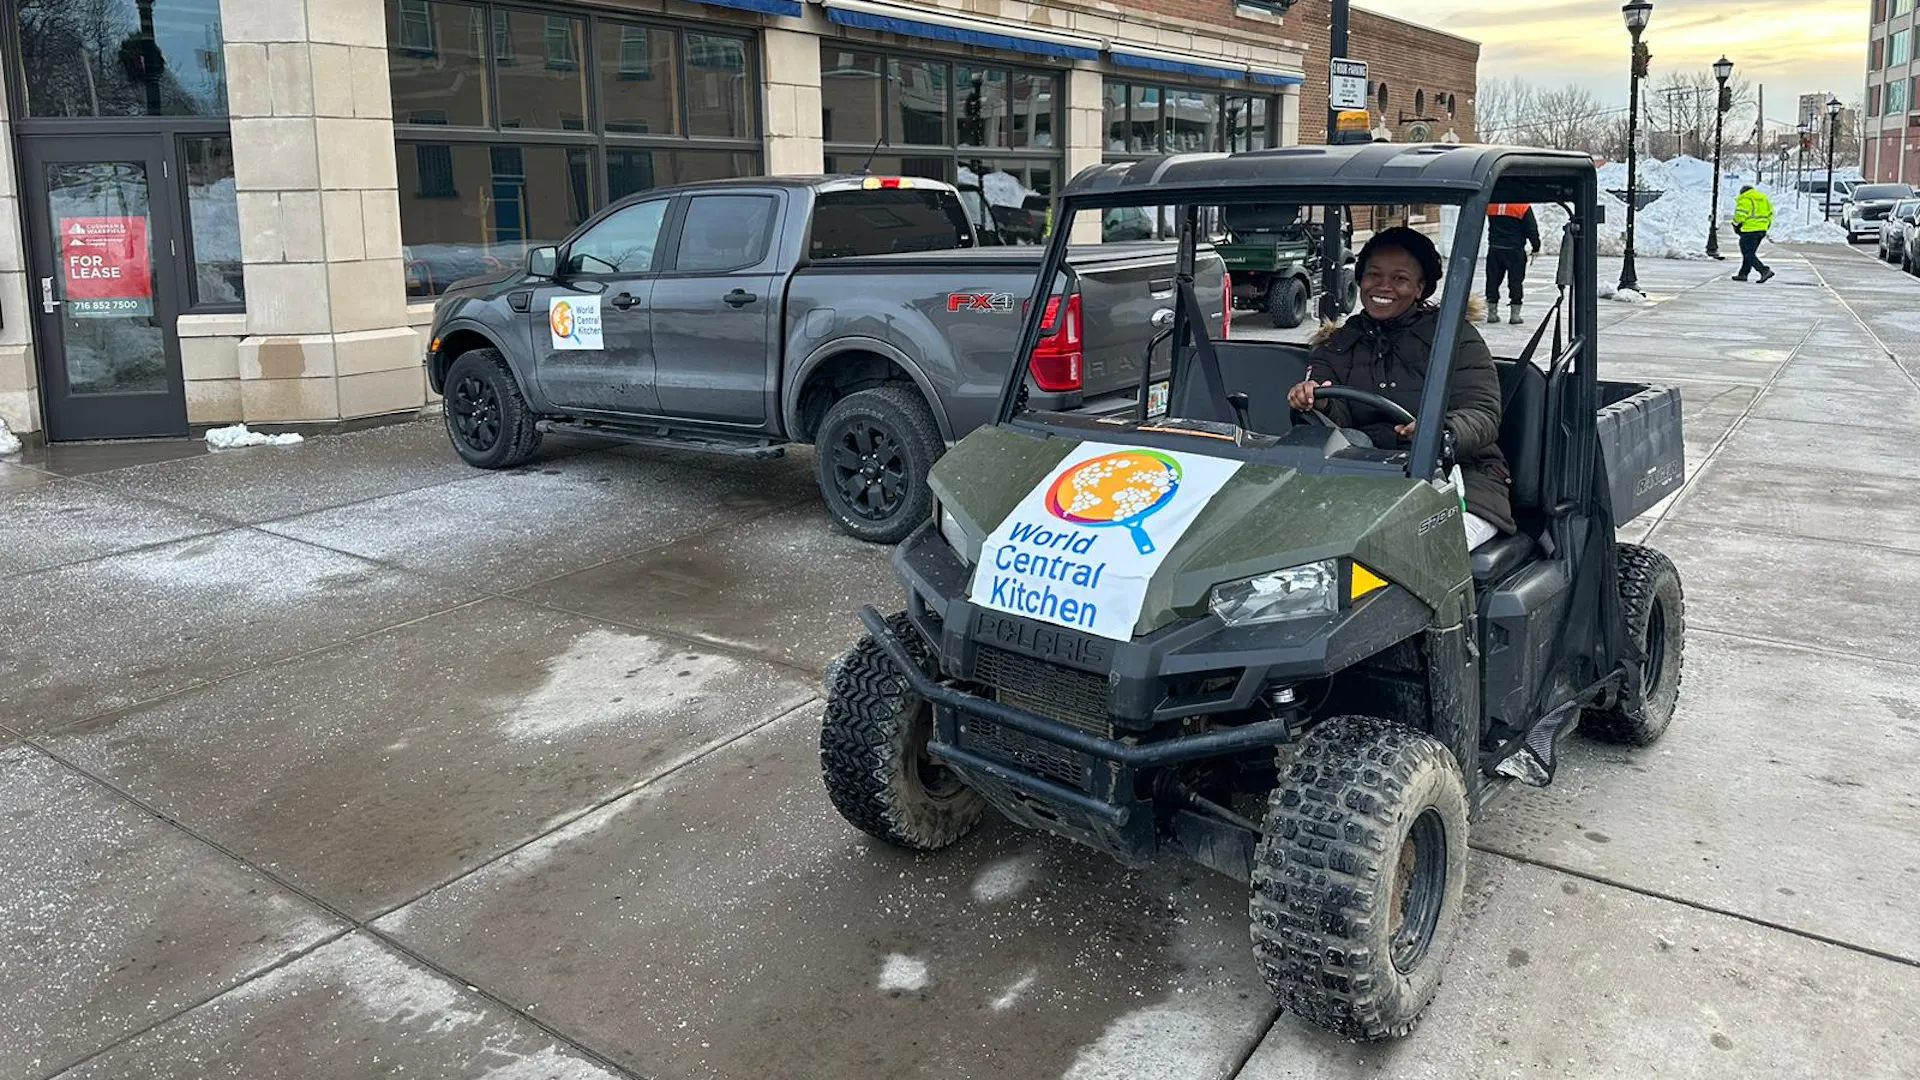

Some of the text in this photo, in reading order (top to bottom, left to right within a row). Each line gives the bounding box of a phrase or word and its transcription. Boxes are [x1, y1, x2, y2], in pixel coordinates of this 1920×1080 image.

[71, 256, 103, 267] FOR
[71, 267, 121, 279] LEASE
[75, 301, 137, 310] 716 852 7500
[947, 293, 1014, 312] FX4
[576, 305, 594, 314] World
[577, 316, 600, 325] Central
[578, 326, 601, 335] Kitchen
[1007, 521, 1098, 555] World
[995, 545, 1106, 589] Central
[990, 575, 1098, 628] Kitchen
[976, 612, 1106, 663] POLARIS
